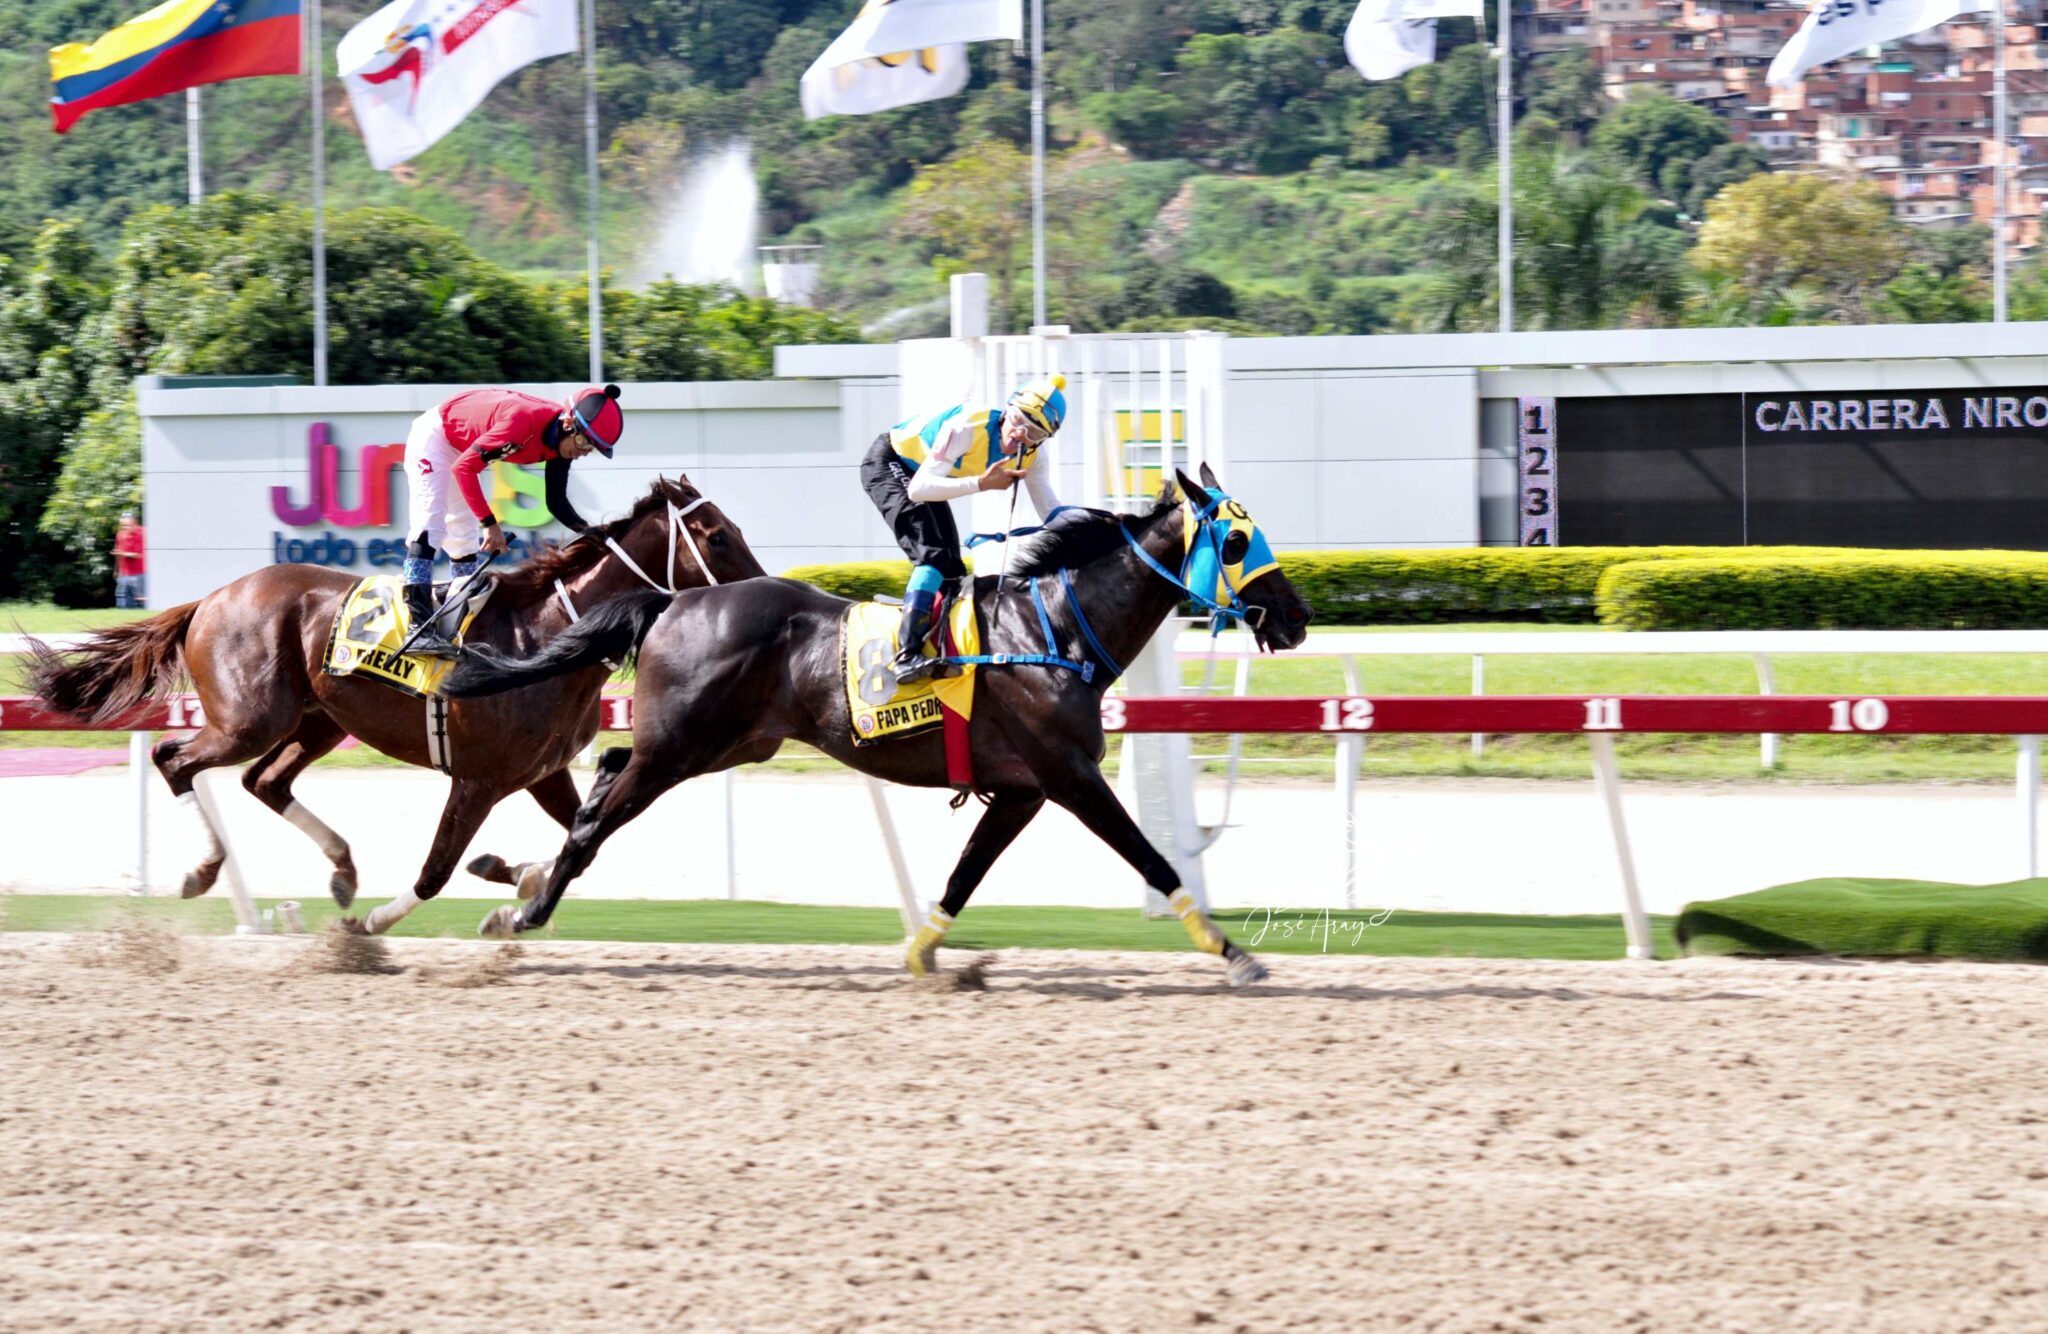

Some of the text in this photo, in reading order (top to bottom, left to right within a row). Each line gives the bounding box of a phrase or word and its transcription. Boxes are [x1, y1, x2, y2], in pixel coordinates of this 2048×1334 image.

[1525, 406, 1547, 434] 1
[1755, 396, 2048, 432] CARRERA NRO
[1527, 447, 1549, 475] 2
[1526, 488, 1549, 516] 3
[272, 530, 356, 566] todo
[1526, 528, 1550, 547] 4
[346, 586, 393, 645] 2
[858, 638, 898, 706] 8
[608, 698, 634, 730] 1
[876, 705, 911, 730] PAPA
[911, 696, 943, 721] PEDR
[1100, 698, 1127, 730] 3
[1319, 698, 1375, 731] 12
[1582, 698, 1624, 730] 11
[1828, 698, 1890, 731] 10
